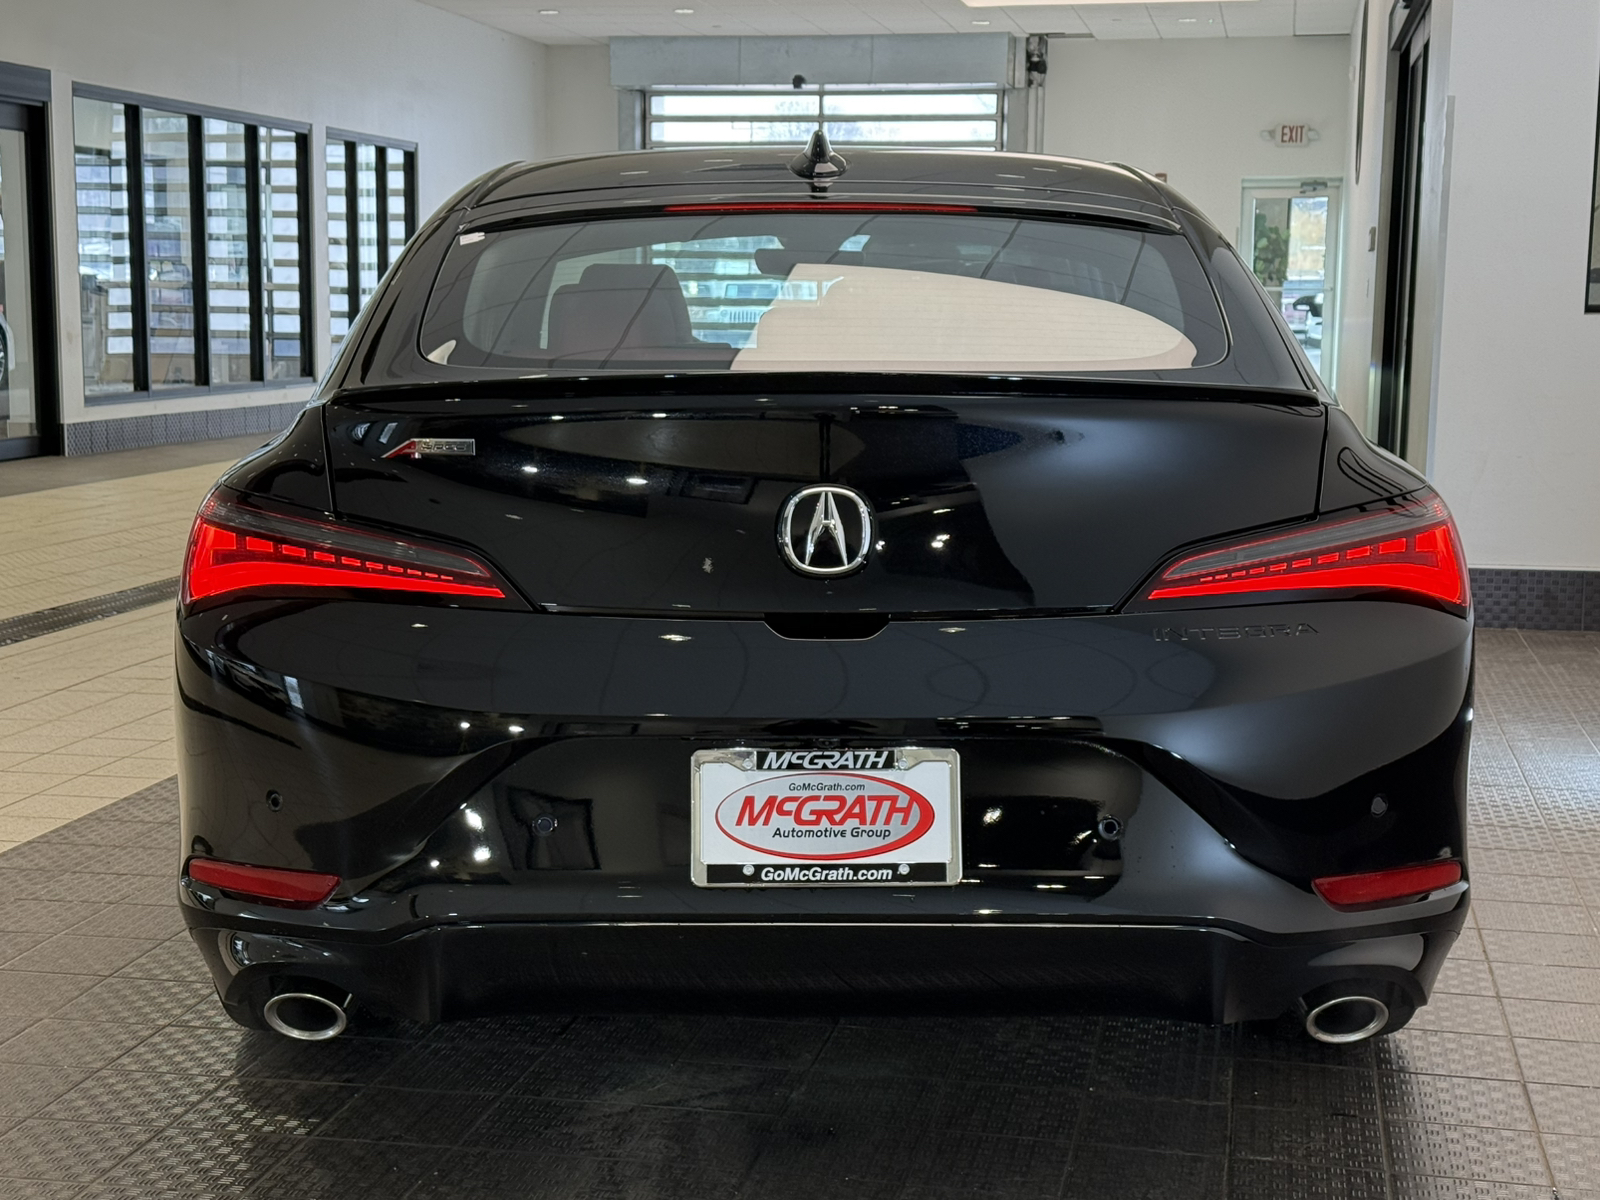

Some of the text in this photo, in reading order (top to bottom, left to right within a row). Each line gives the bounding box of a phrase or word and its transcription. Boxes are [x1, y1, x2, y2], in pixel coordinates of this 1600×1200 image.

[1281, 125, 1305, 143] EXIT
[1153, 623, 1319, 641] INTEGRA
[788, 782, 865, 792] GoMcGrath.com
[772, 827, 891, 840] Automotive Group
[761, 866, 892, 881] GoMcGrath.com
